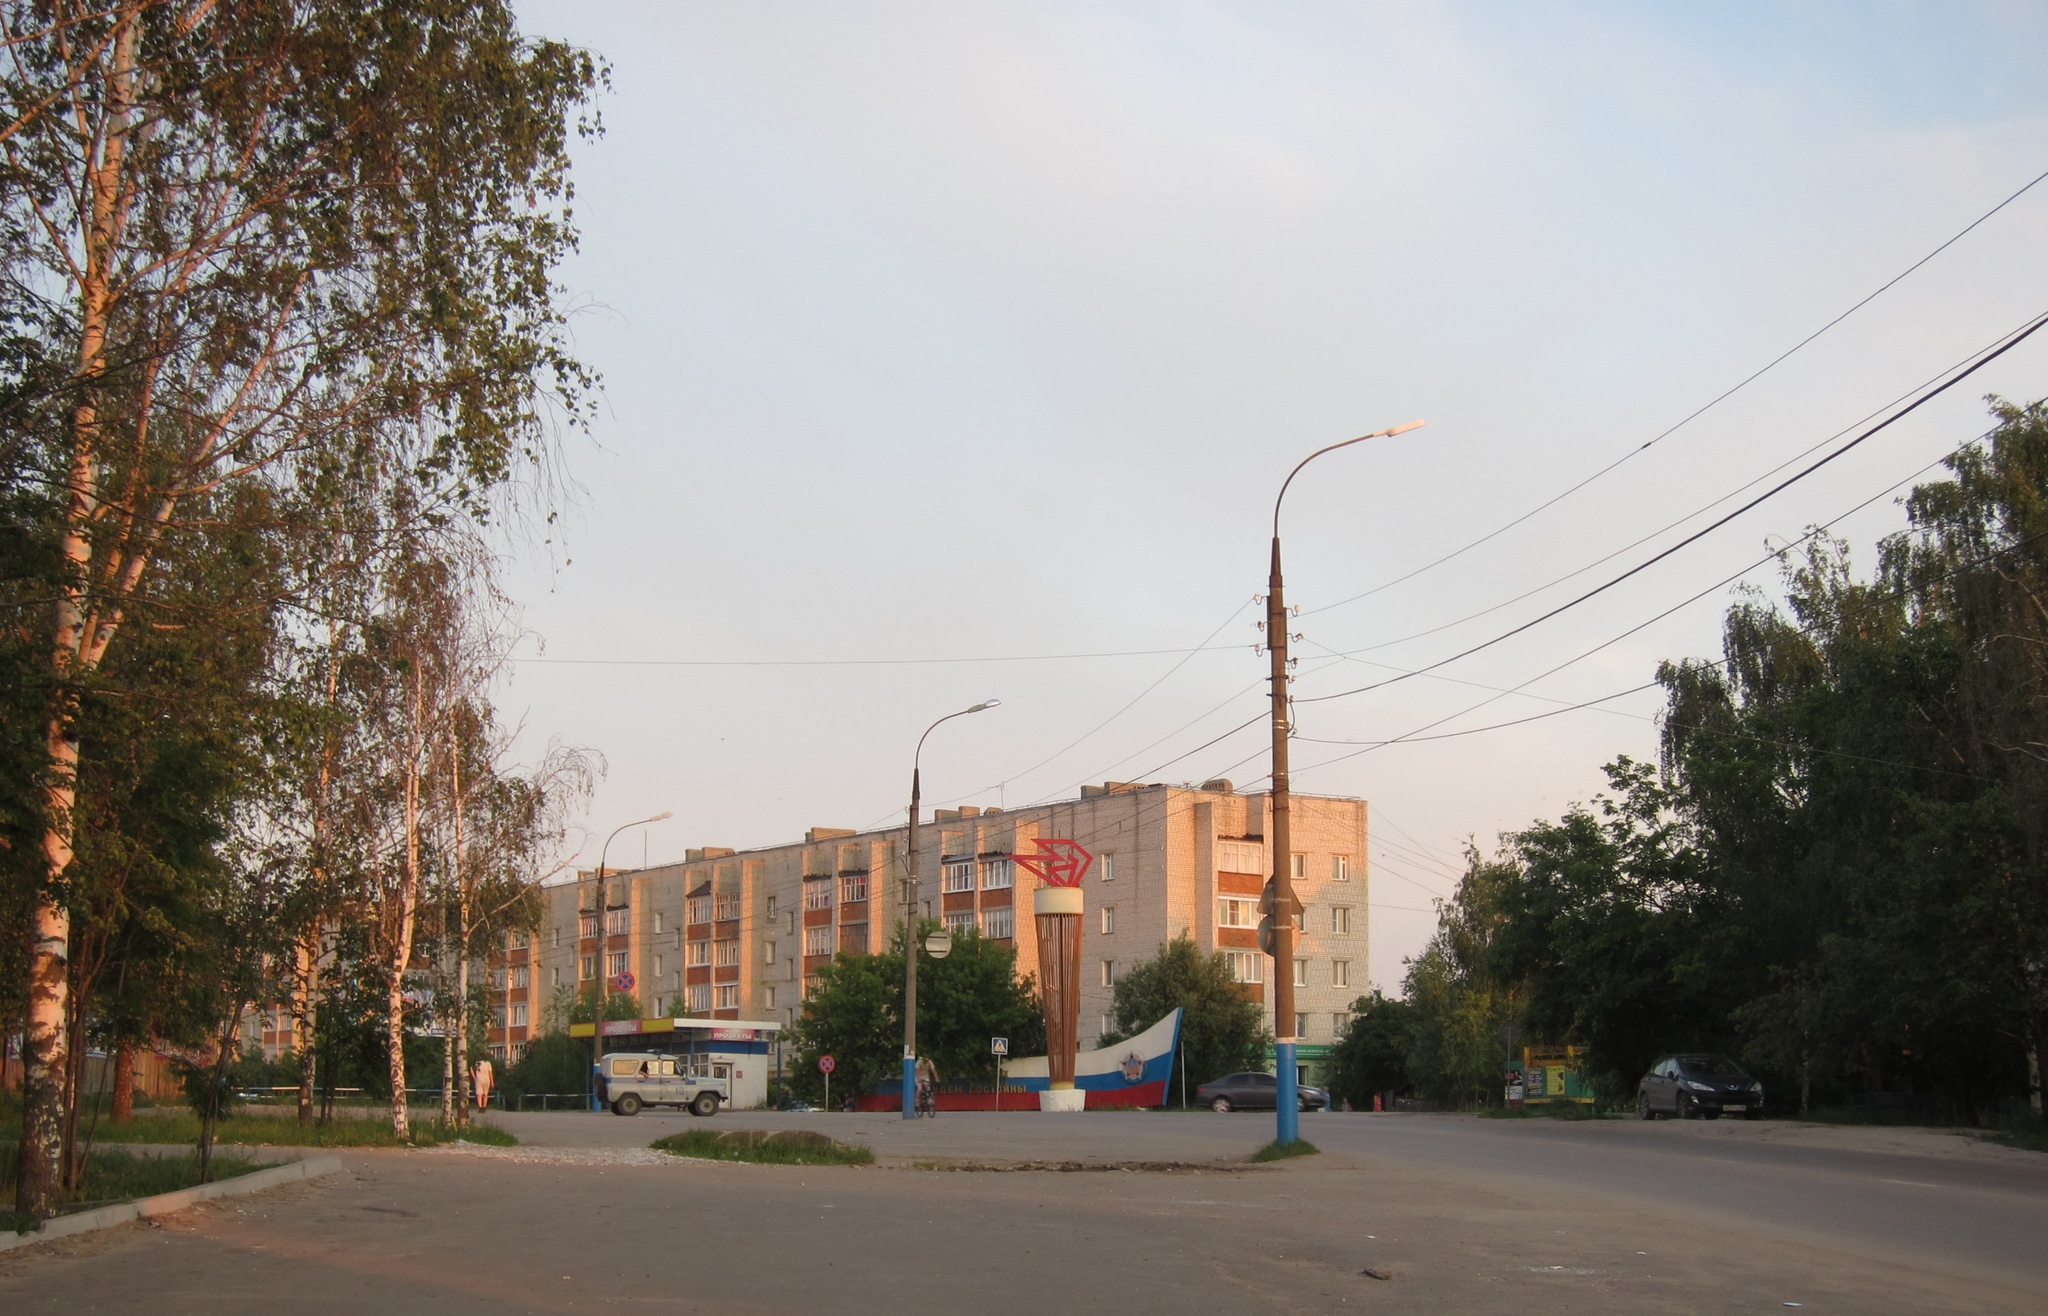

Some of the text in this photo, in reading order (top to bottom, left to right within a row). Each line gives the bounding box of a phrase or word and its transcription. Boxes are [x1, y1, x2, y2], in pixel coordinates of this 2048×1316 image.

[605, 1024, 637, 1034] ПРОДУКТЫ
[713, 1032, 752, 1040] ПРОДУКТЫ
[932, 1085, 963, 1094] УДЕМ
